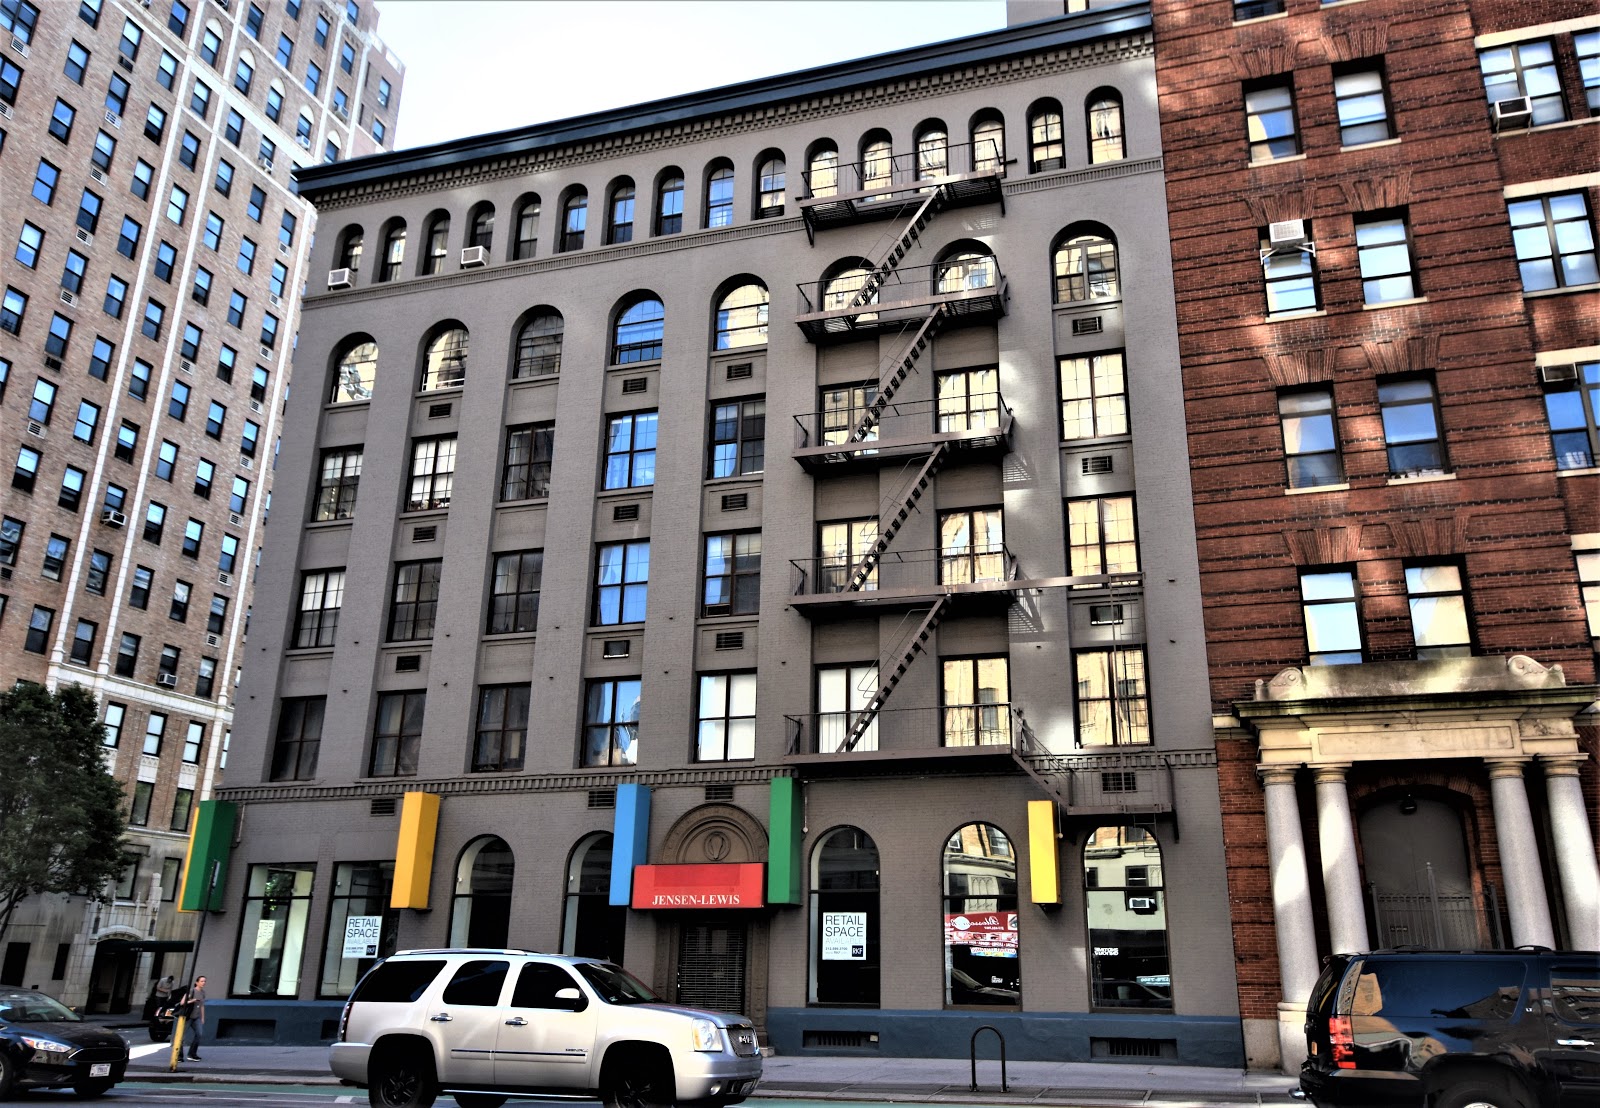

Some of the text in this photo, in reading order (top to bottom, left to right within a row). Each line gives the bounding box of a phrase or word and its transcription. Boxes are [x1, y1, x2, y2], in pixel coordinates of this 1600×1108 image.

[652, 894, 740, 905] JENSEN-LEWIS
[348, 918, 379, 927] RETAIL
[825, 915, 864, 925] RETAIL
[347, 929, 378, 938] SPACE
[825, 926, 864, 938] SPACE
